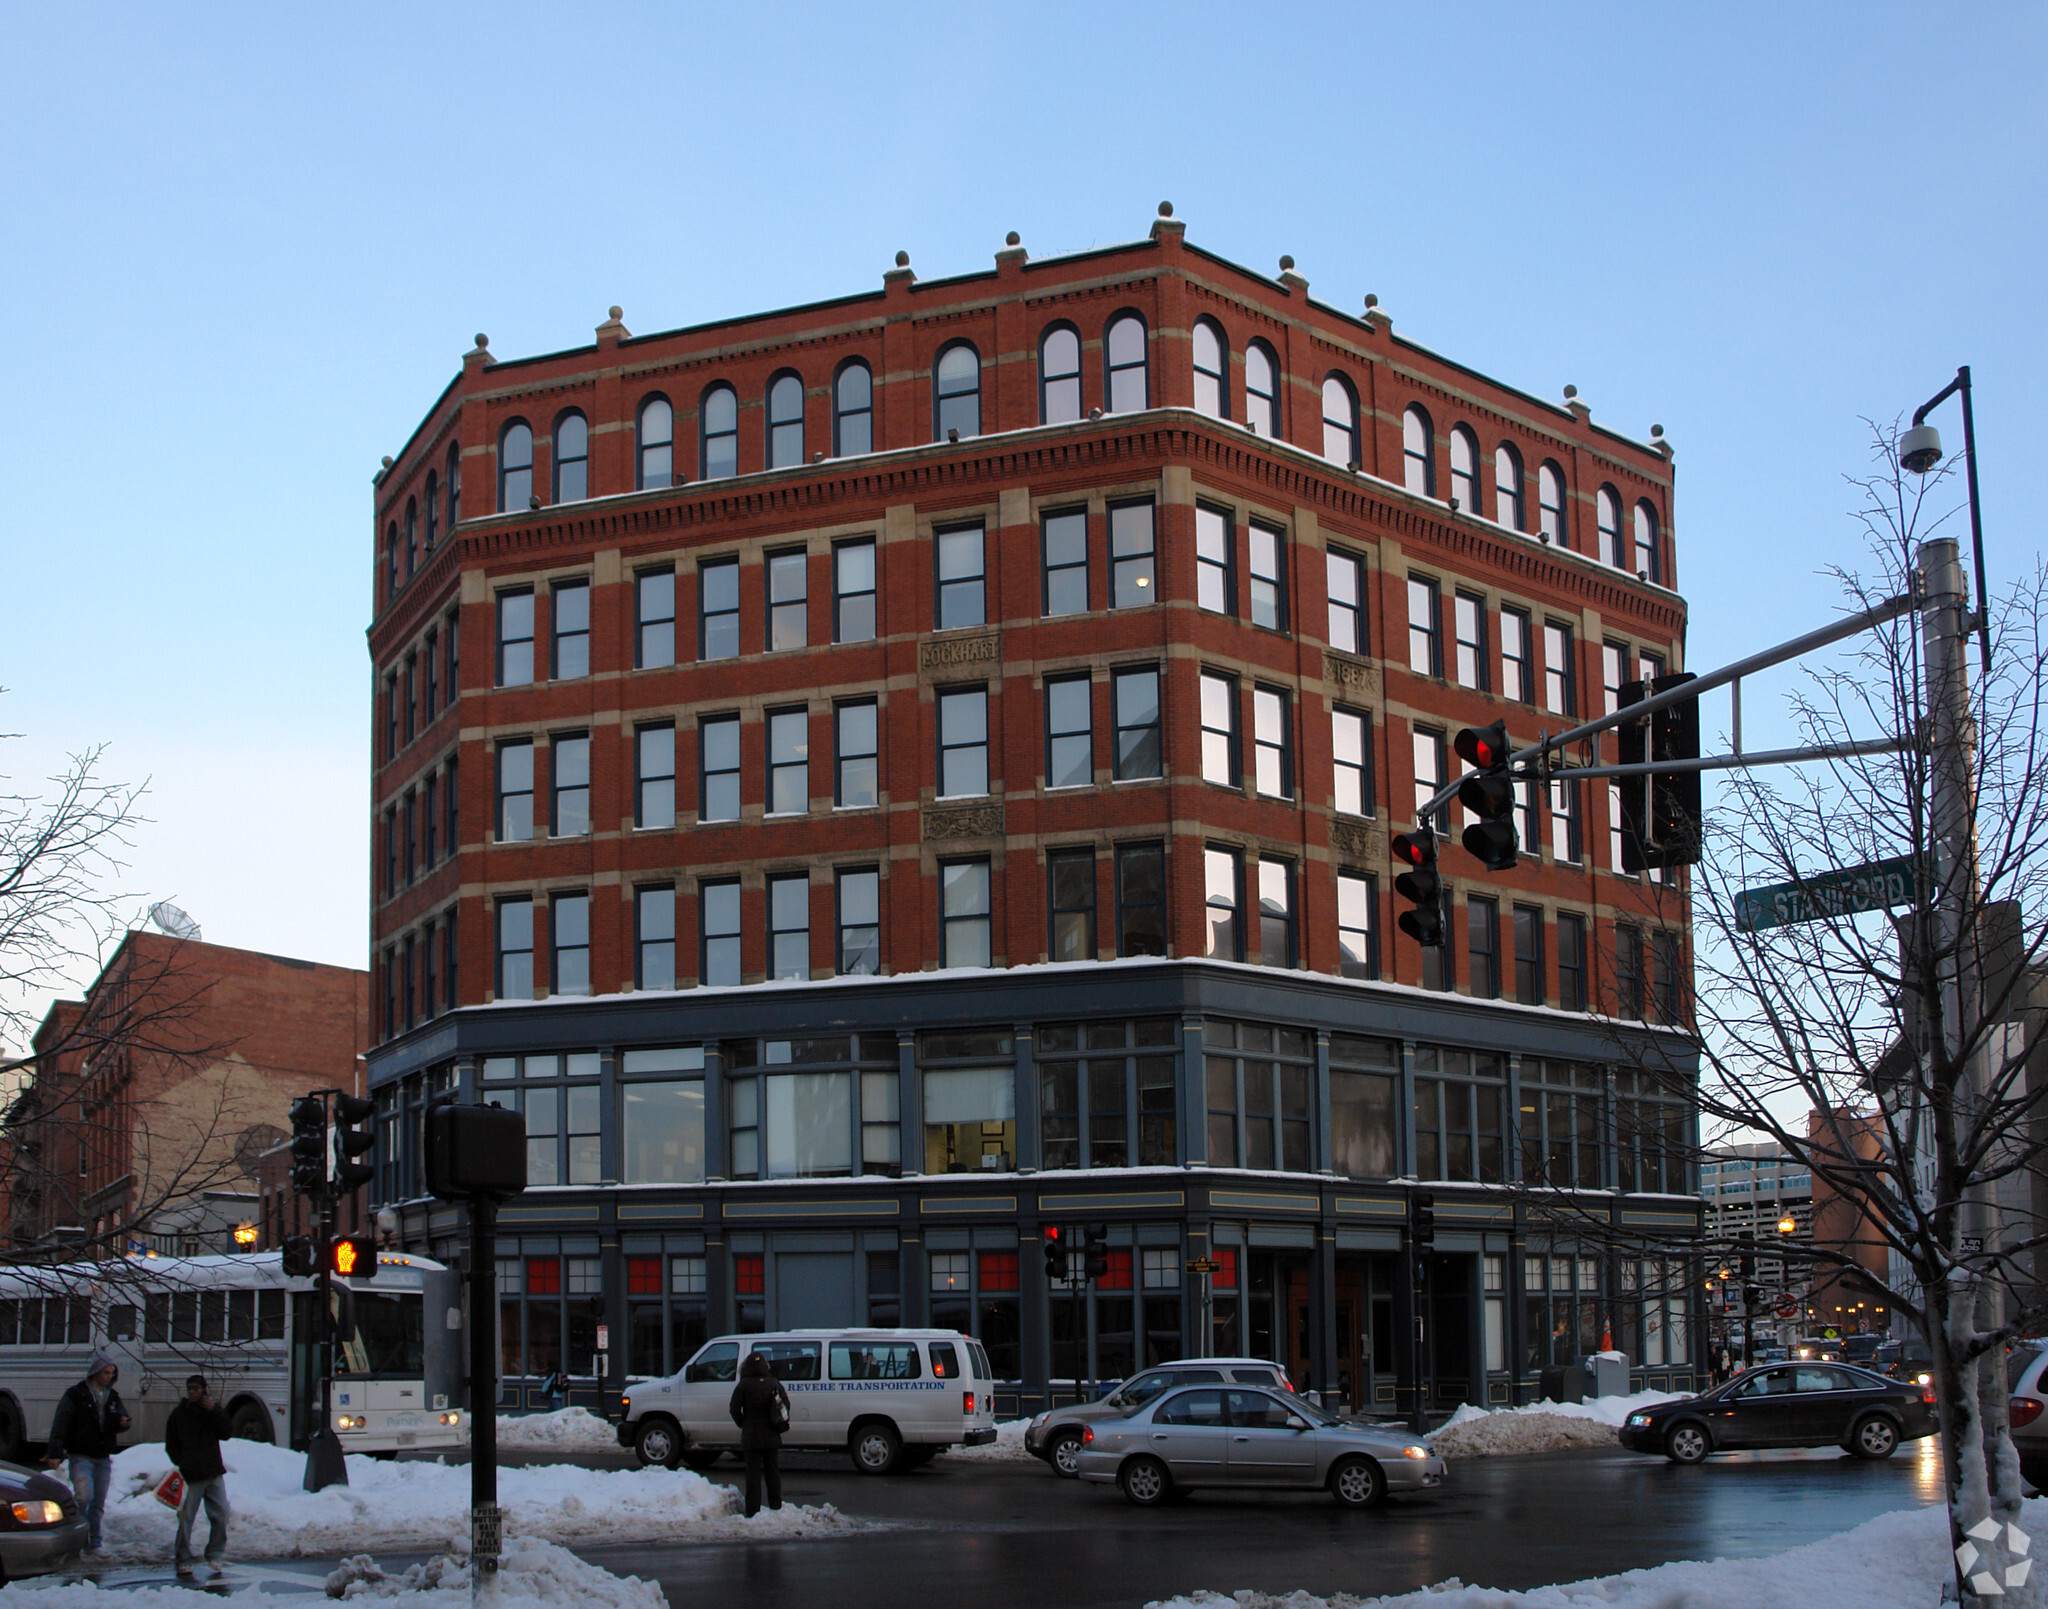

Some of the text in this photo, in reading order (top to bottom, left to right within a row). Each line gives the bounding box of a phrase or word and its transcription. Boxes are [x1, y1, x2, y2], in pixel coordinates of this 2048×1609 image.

[922, 640, 1000, 667] LOCKHART
[1336, 662, 1367, 688] 1887
[787, 1381, 945, 1392] REVERE TRANSPORTATION
